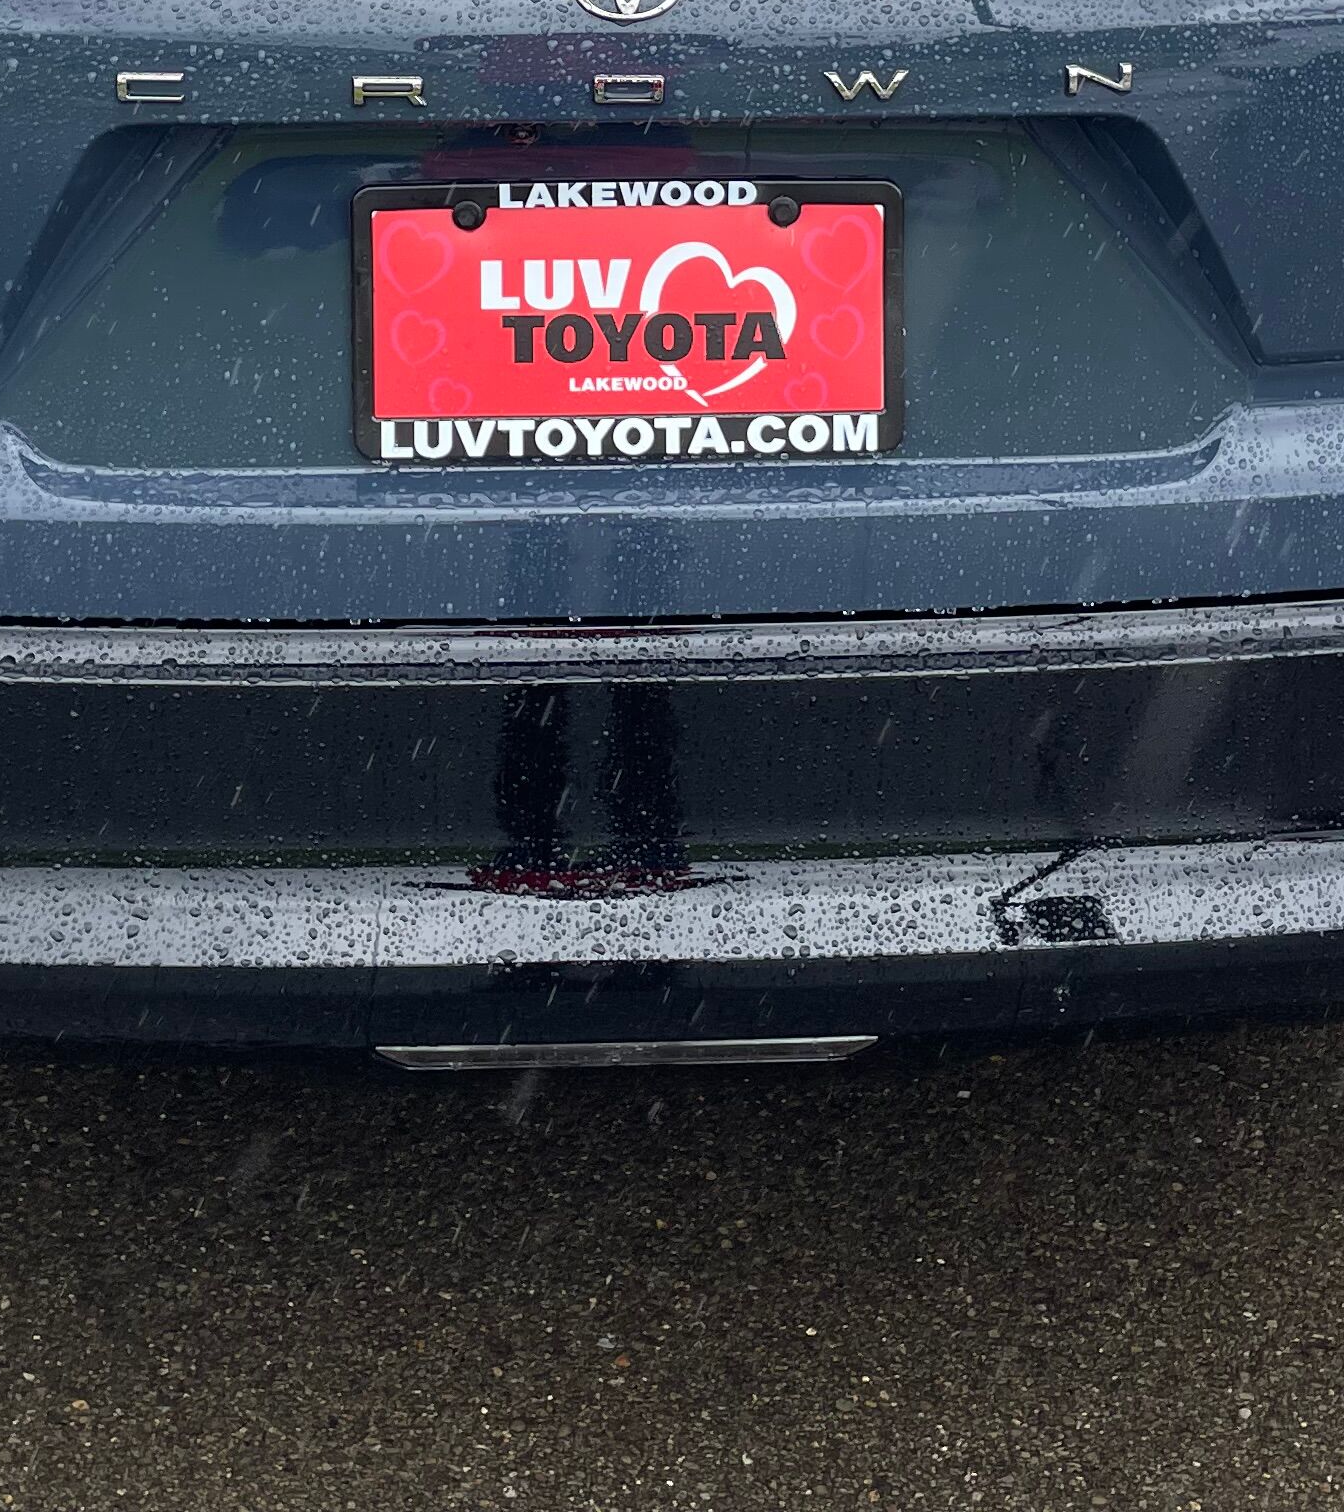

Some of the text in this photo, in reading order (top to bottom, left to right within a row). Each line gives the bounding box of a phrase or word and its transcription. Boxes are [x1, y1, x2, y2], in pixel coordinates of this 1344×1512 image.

[115, 62, 1134, 107] CROWN
[498, 180, 757, 209] LAKEWOOD
[480, 258, 632, 311] LUV
[502, 312, 786, 364] TOYOTA
[569, 376, 688, 392] LAKEWOOD
[380, 414, 880, 460] LUVTOYOTA.COM
